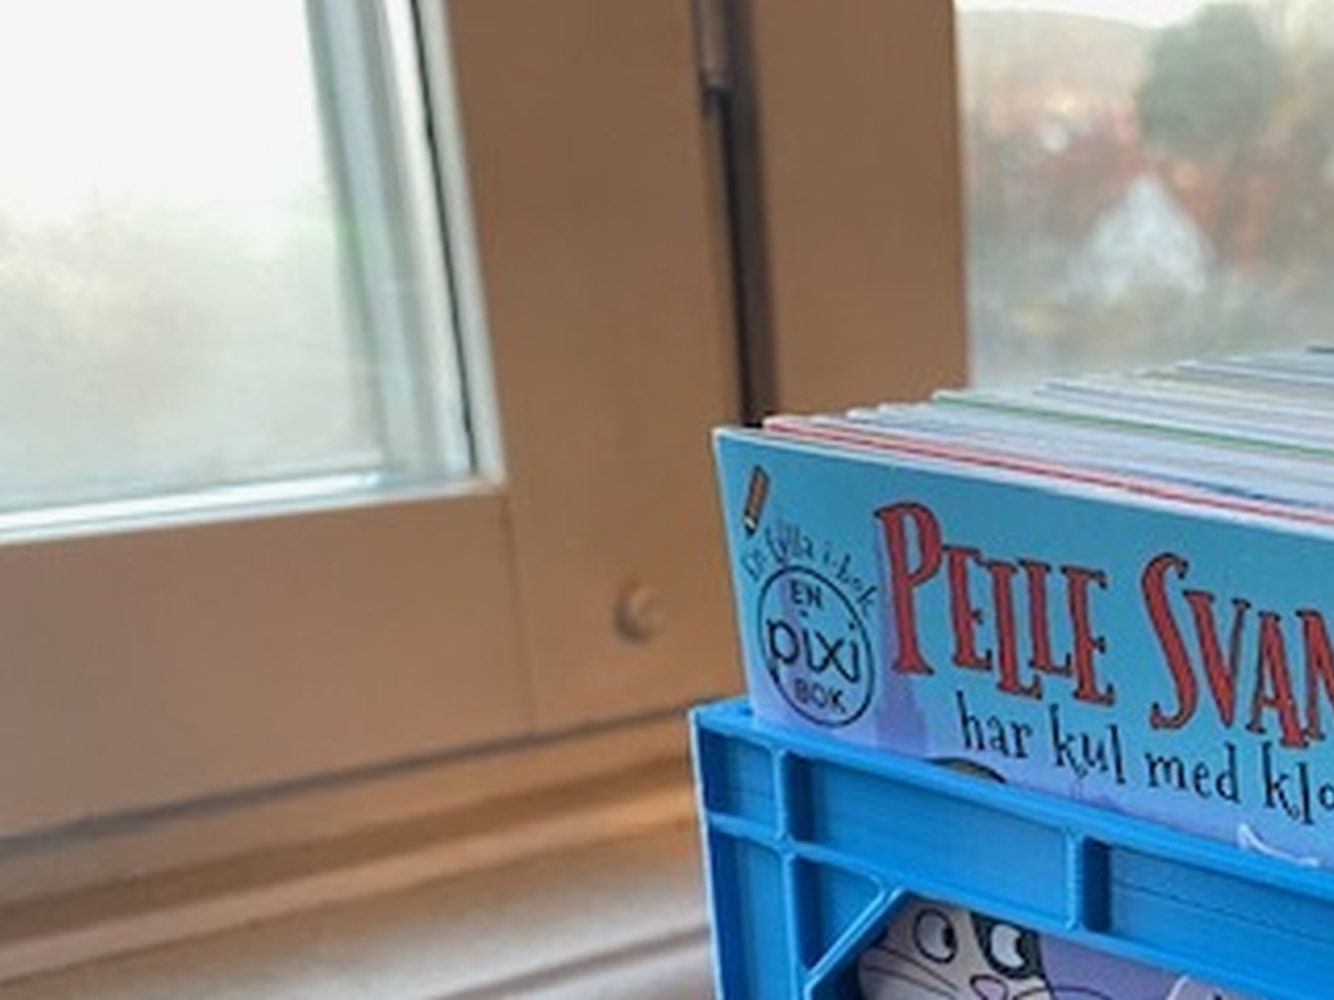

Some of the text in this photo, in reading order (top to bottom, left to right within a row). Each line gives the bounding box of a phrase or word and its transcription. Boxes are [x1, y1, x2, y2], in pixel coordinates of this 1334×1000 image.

[790, 579, 823, 610] EN
[874, 501, 1118, 706] PELLE
[765, 610, 861, 684] pixi
[794, 677, 848, 715] BOK
[956, 690, 1033, 759] har
[1049, 703, 1126, 785] kul
[1145, 742, 1241, 804] med
